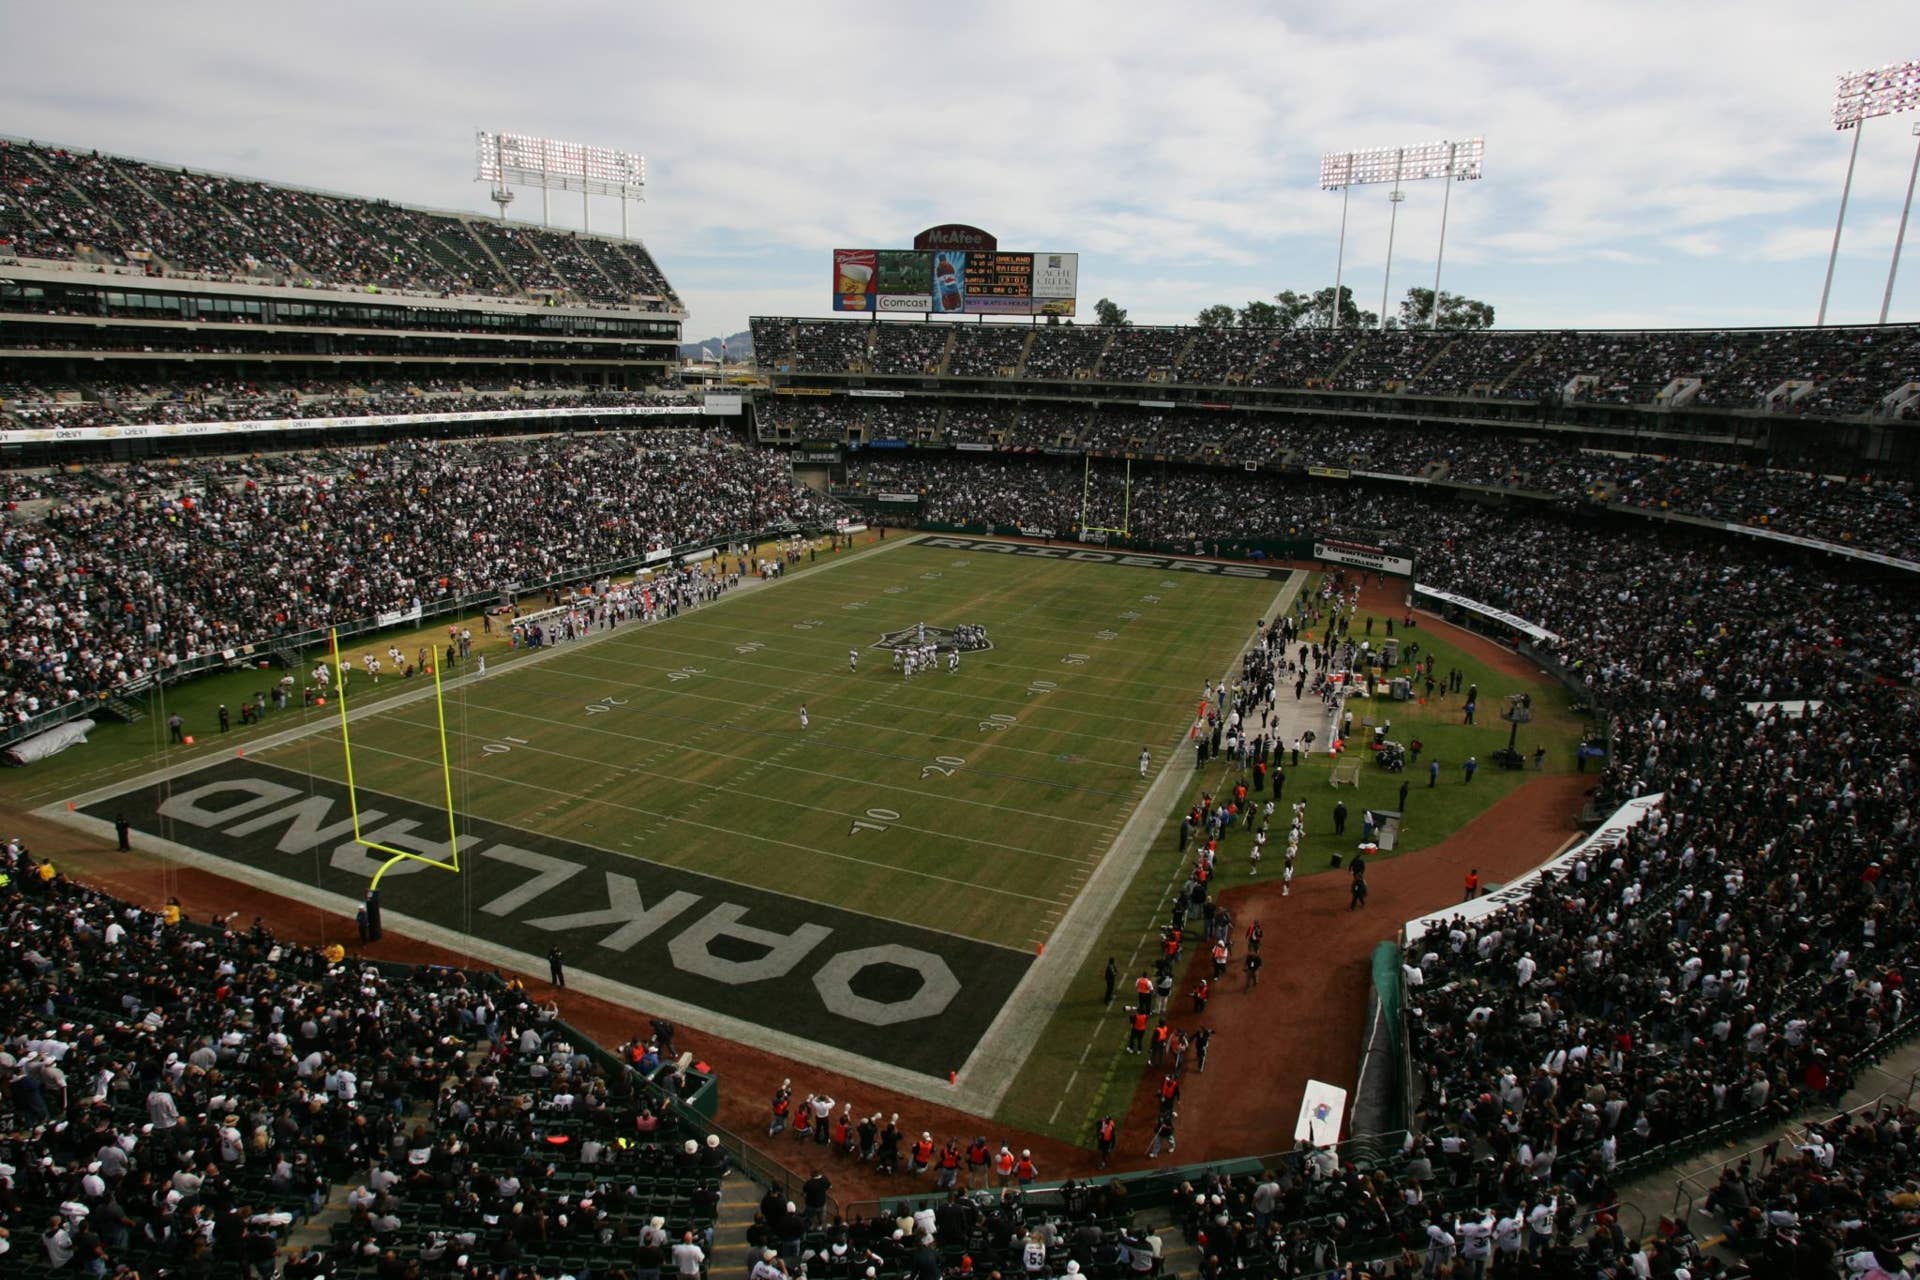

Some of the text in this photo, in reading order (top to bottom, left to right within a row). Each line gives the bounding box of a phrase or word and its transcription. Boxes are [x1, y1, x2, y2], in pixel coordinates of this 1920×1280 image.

[928, 229, 982, 244] McAfee
[882, 296, 928, 308] comcast
[56, 431, 81, 439] CHEVY
[124, 428, 147, 436] CHEVY
[926, 537, 1279, 579] RAIDERS
[1327, 546, 1385, 562] COMMITMENT
[1340, 557, 1384, 569] EXCELLENCE
[1448, 595, 1494, 613] OAKLAND
[667, 665, 707, 681] 30
[1027, 679, 1058, 696] 40
[585, 695, 629, 714] 20
[980, 713, 1018, 733] 30
[482, 735, 529, 755] 10
[922, 755, 967, 779] 20
[851, 807, 902, 834] 10
[157, 777, 962, 1027] OAKLAND
[1029, 1253, 1044, 1266] 53
